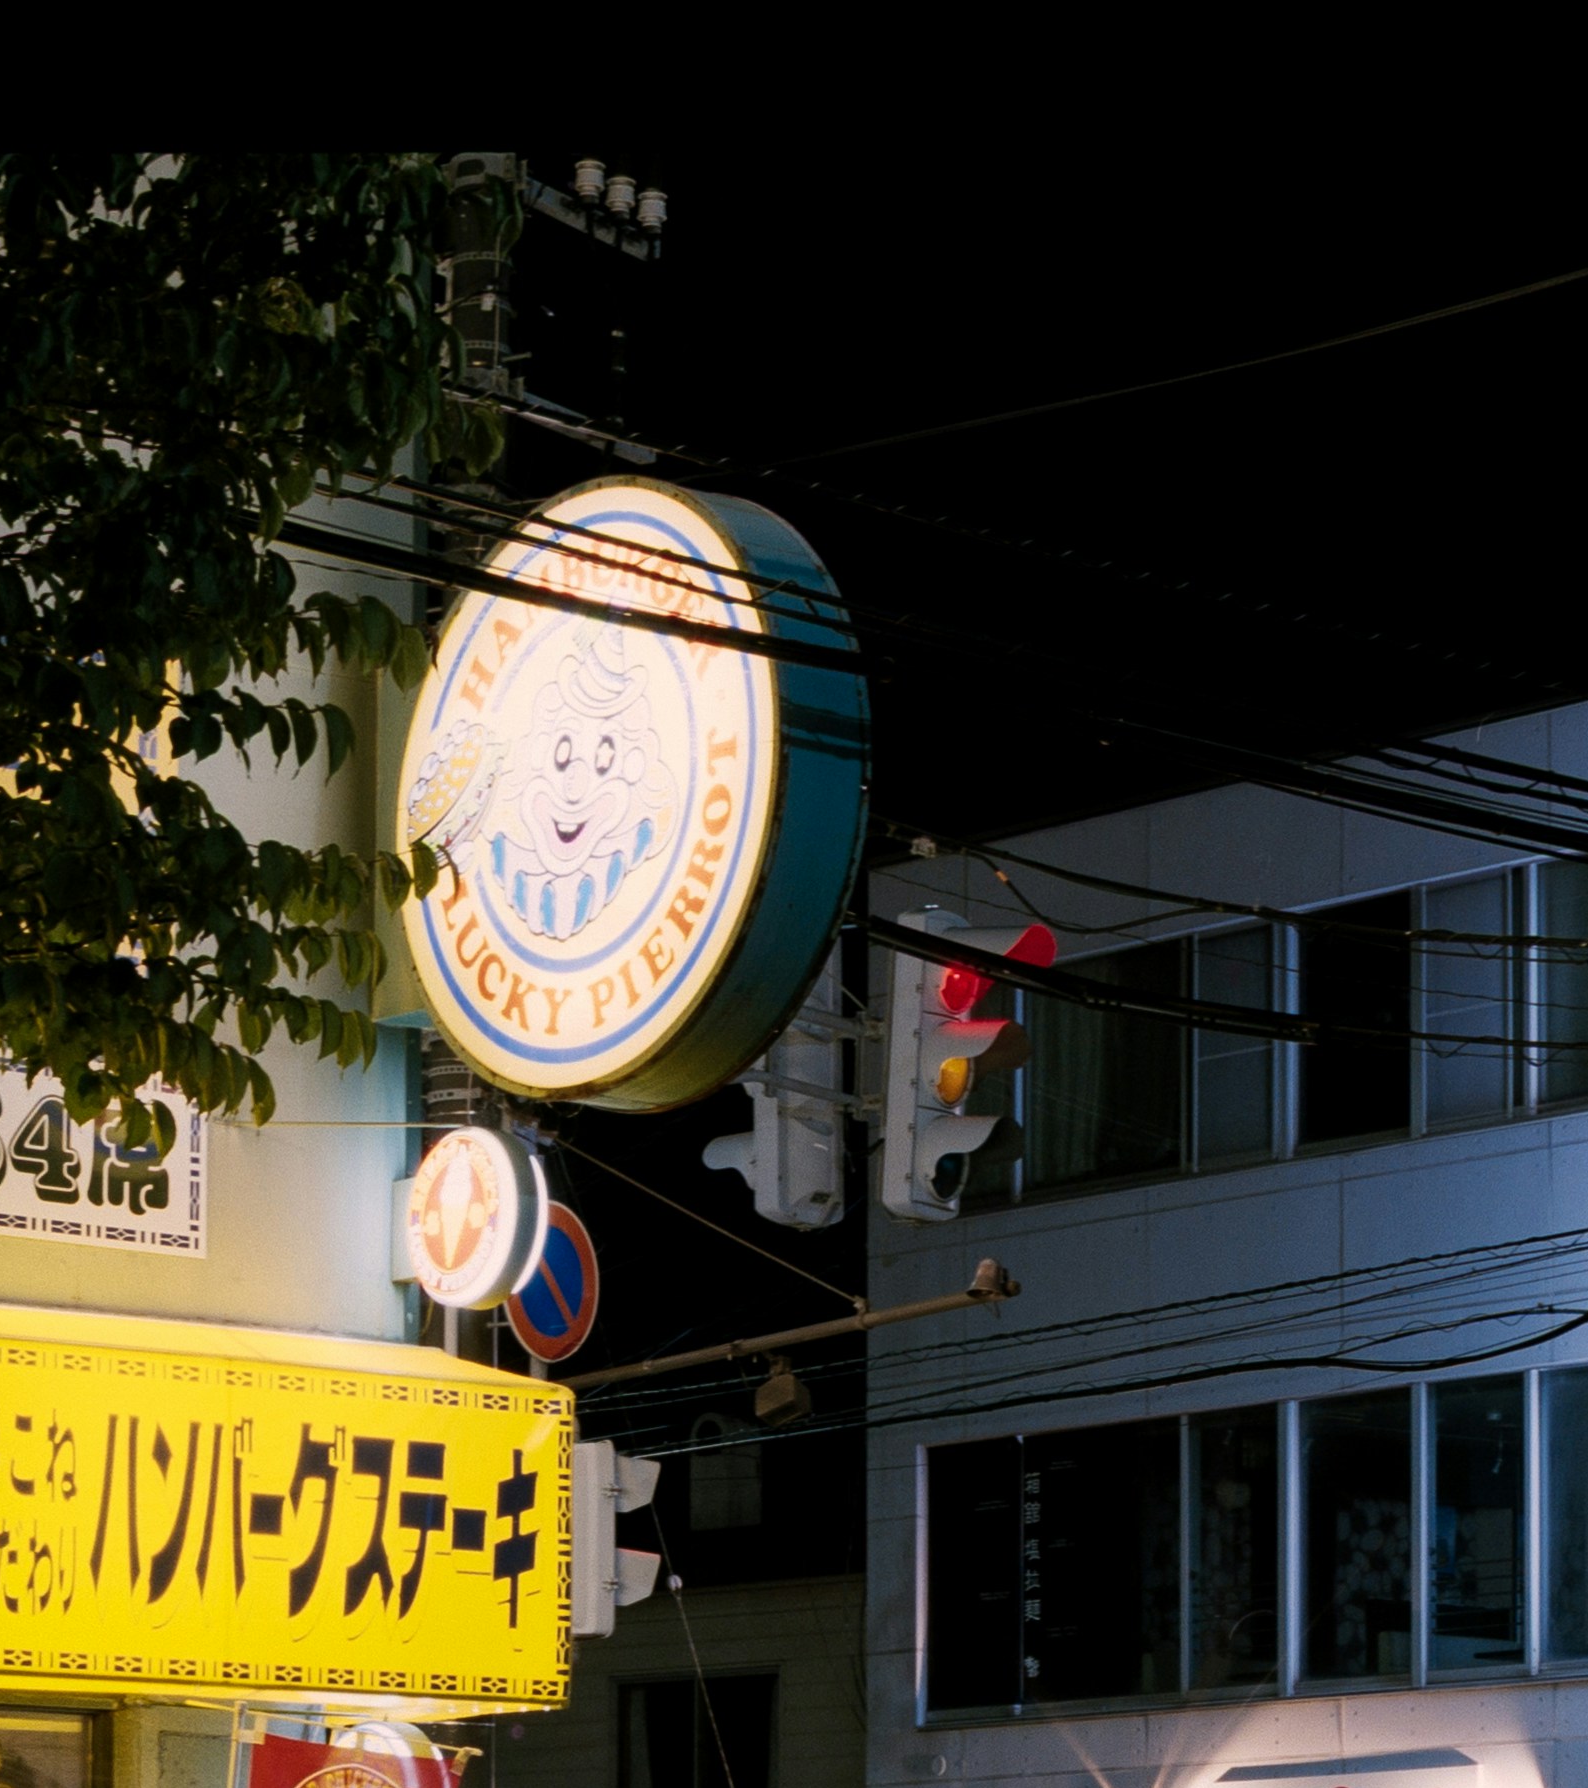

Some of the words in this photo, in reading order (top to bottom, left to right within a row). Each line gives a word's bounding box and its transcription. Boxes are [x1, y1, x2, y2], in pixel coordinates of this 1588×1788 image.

[441, 879, 573, 1036] LUCKY
[586, 726, 737, 1029] PIERROT
[90, 1412, 540, 1640] ハンバーグステーキ
